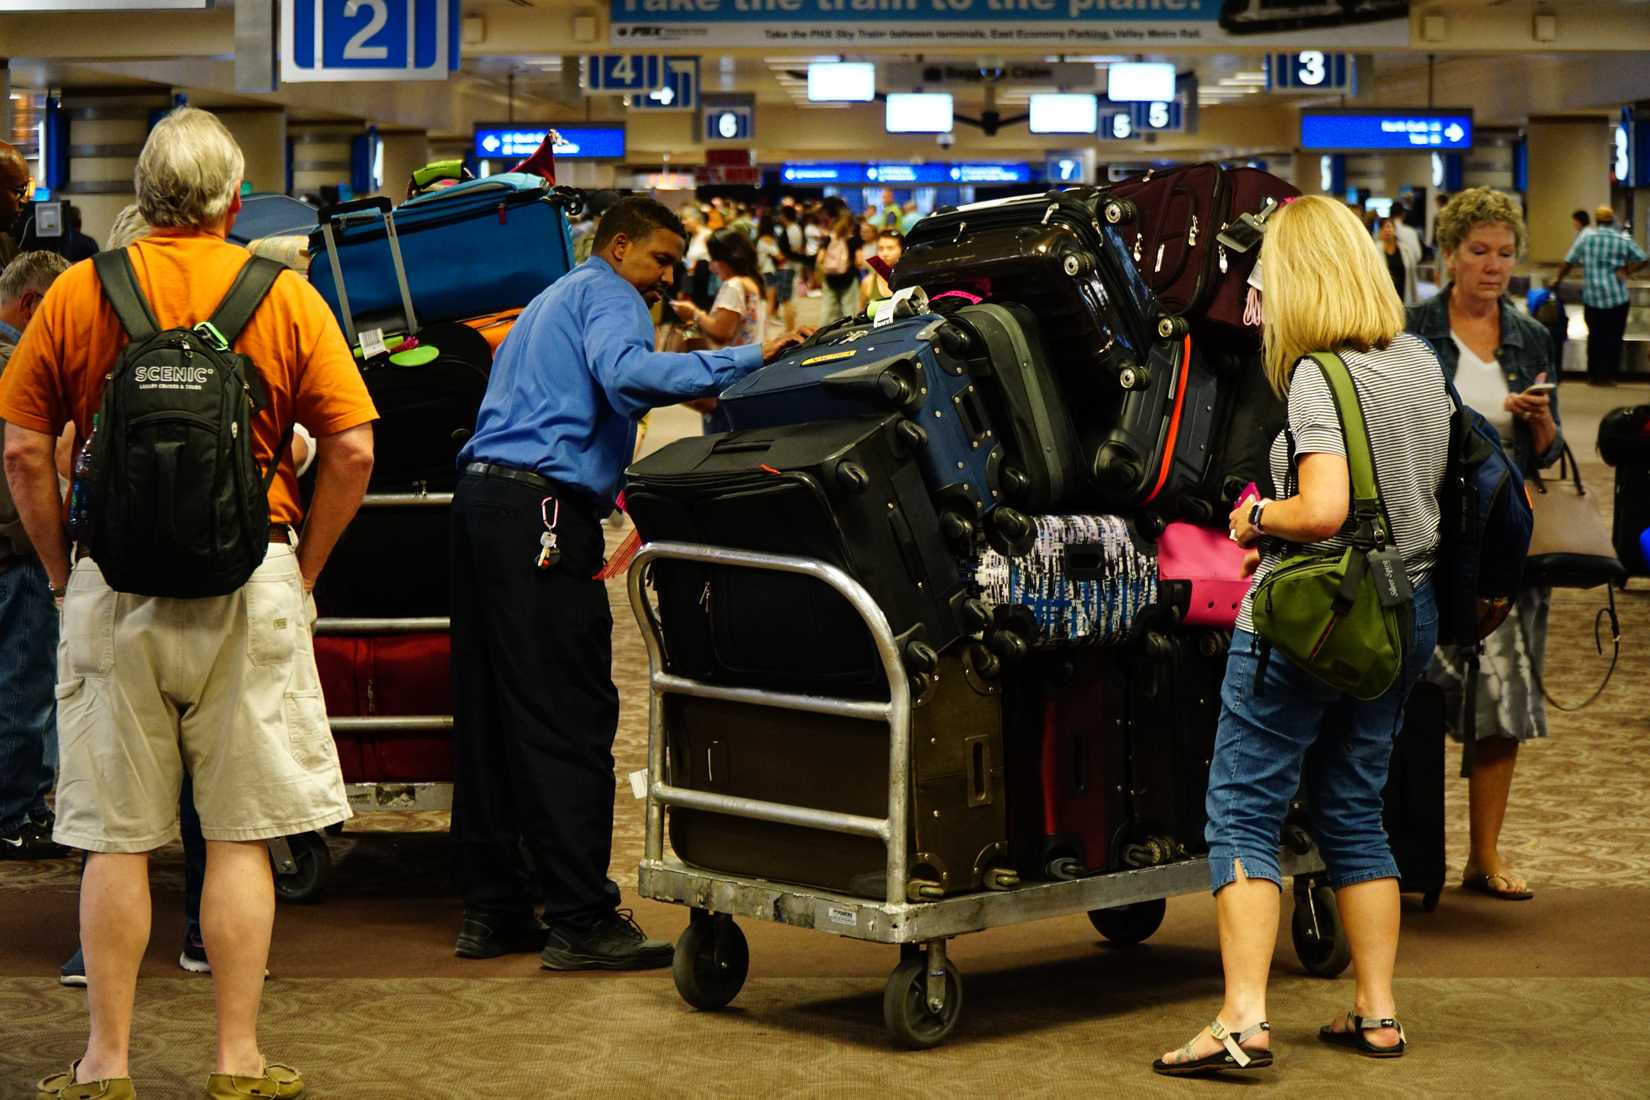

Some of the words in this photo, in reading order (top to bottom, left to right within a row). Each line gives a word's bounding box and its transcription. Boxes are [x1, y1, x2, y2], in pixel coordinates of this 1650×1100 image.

[343, 0, 388, 59] 2
[791, 30, 807, 39] the
[611, 55, 636, 85] 4
[1298, 50, 1326, 85] 3
[719, 112, 738, 138] 6
[1149, 101, 1169, 128] 5
[1058, 159, 1076, 180] 7
[134, 366, 208, 383] SCENIC
